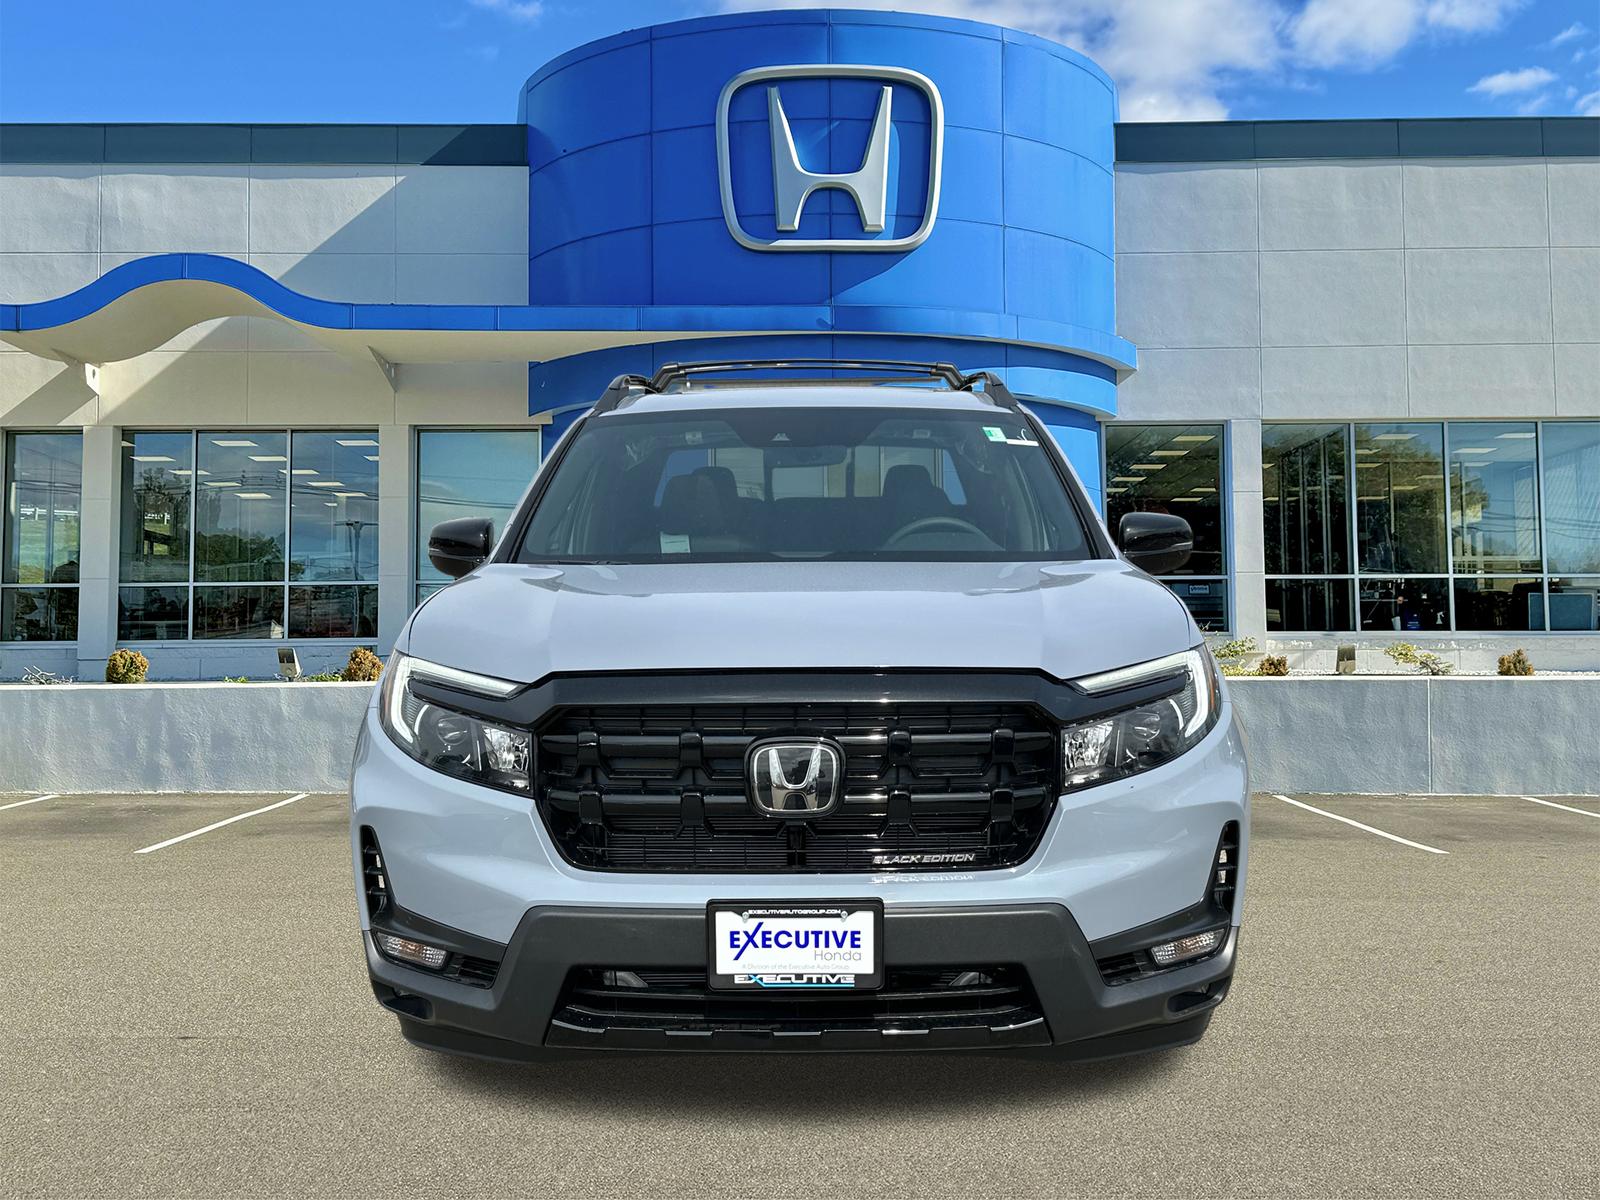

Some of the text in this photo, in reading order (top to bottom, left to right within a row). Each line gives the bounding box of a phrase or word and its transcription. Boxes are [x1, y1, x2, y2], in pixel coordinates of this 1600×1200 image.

[873, 853, 975, 864] BLACK EDITION
[729, 922, 861, 961] EXECUTIVE
[814, 950, 862, 961] Honda
[734, 974, 855, 986] EXECUTIVE
